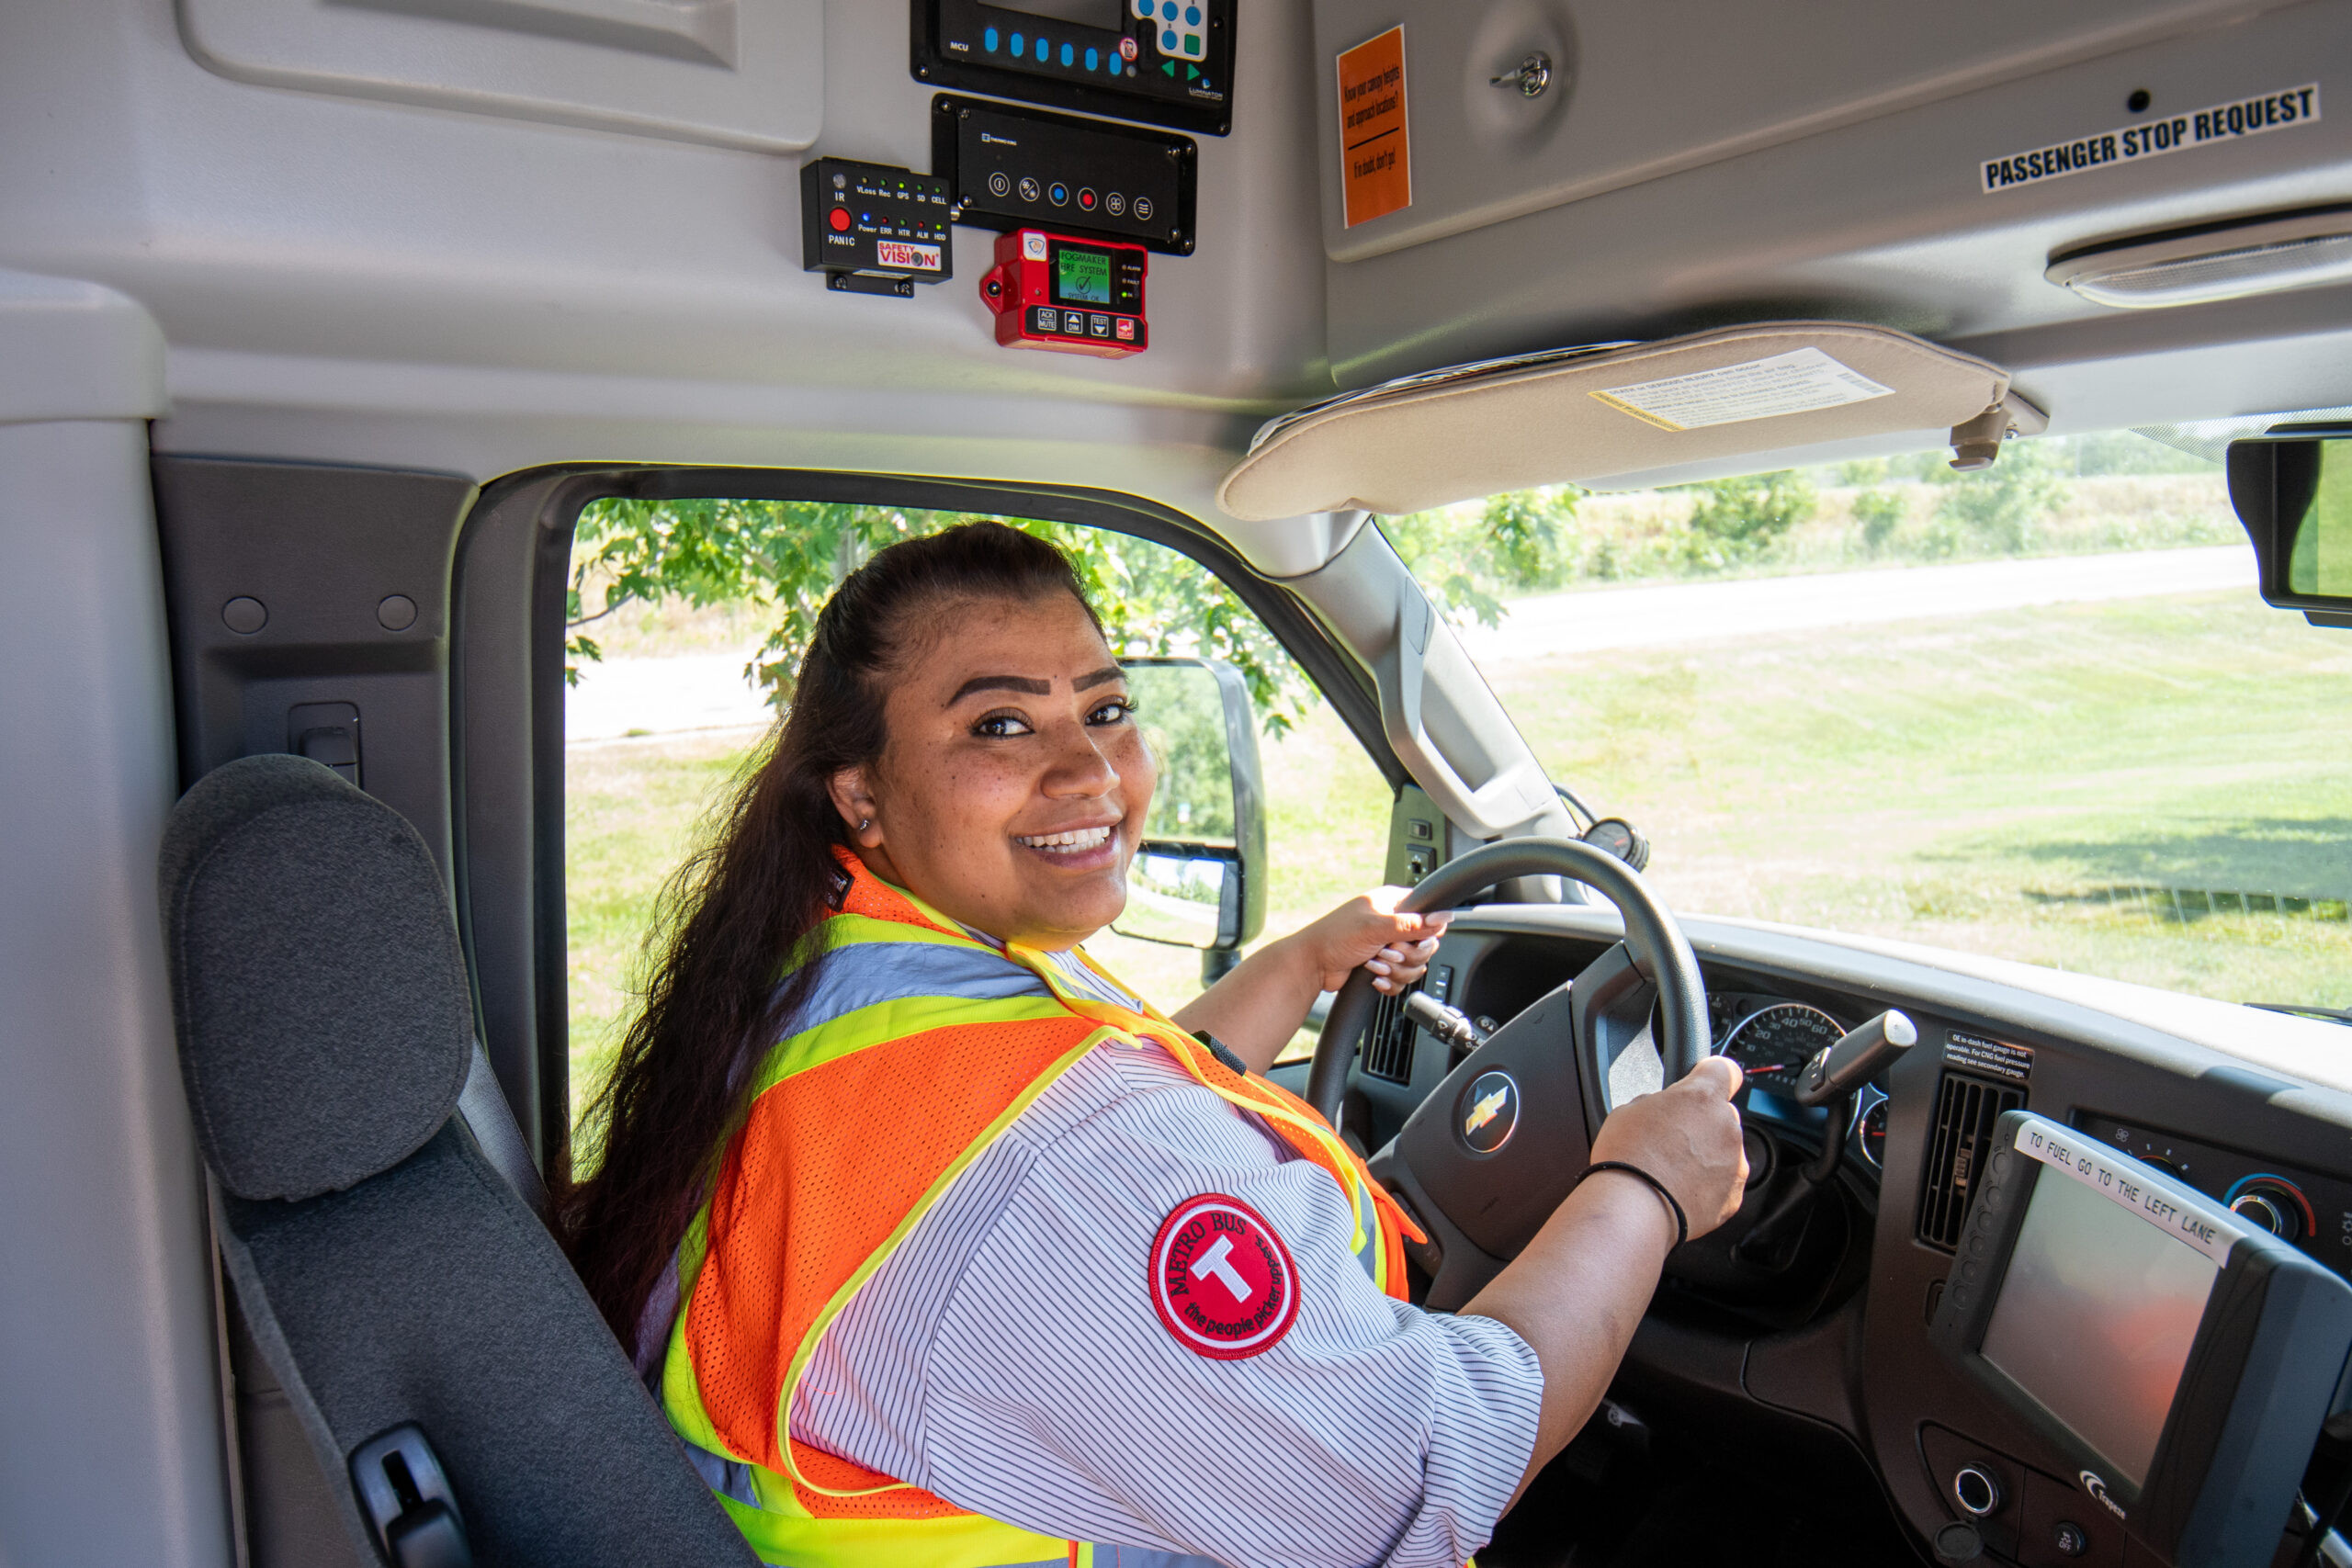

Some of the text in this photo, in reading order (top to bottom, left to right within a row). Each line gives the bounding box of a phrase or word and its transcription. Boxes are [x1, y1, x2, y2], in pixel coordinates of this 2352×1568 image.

[950, 42, 969, 52] MCU
[1985, 88, 2314, 189] PASSENGER STOP REQUEST
[834, 191, 844, 201] IR
[878, 188, 891, 197] Rec
[897, 191, 910, 200] GPS
[917, 194, 926, 202] SD
[931, 196, 947, 205] CELL
[858, 224, 946, 241] Power ERR HTR ALM HDD
[829, 233, 855, 246] PANIC
[879, 242, 915, 252] SAFETY
[880, 250, 936, 266] VISION
[1060, 252, 1106, 265] FOGMAKER
[1060, 263, 1107, 276] FIRE SYSTEM
[1069, 292, 1088, 300] SYSTEM
[1039, 320, 1055, 328] MUTE
[1093, 317, 1107, 325] TEST
[1769, 1021, 1781, 1030] 30
[1781, 1017, 1798, 1028] 40
[1799, 1018, 1812, 1027] 50
[1811, 1024, 1827, 1034] 60
[1755, 1030, 1770, 1040] 20
[1952, 1034, 1961, 1043] OE
[1961, 1036, 1982, 1047] in-dash
[1982, 1041, 1993, 1050] fuel
[1993, 1044, 2010, 1055] gauge
[1946, 1043, 2030, 1069] operable. For CNG fuel pressure
[1947, 1053, 1967, 1066] reading
[1977, 1060, 2006, 1074] secondary
[2030, 1132, 2217, 1245] TO FUEL GO TO THE LEFT LANE
[1169, 1213, 1247, 1297] METRO BUS
[1190, 1234, 1252, 1303] T
[1184, 1302, 1207, 1327] the
[1205, 1317, 1255, 1338] people
[1253, 1286, 1281, 1329] picker
[2098, 1489, 2126, 1520] Trapeze
[2059, 1540, 2071, 1551] OFF
